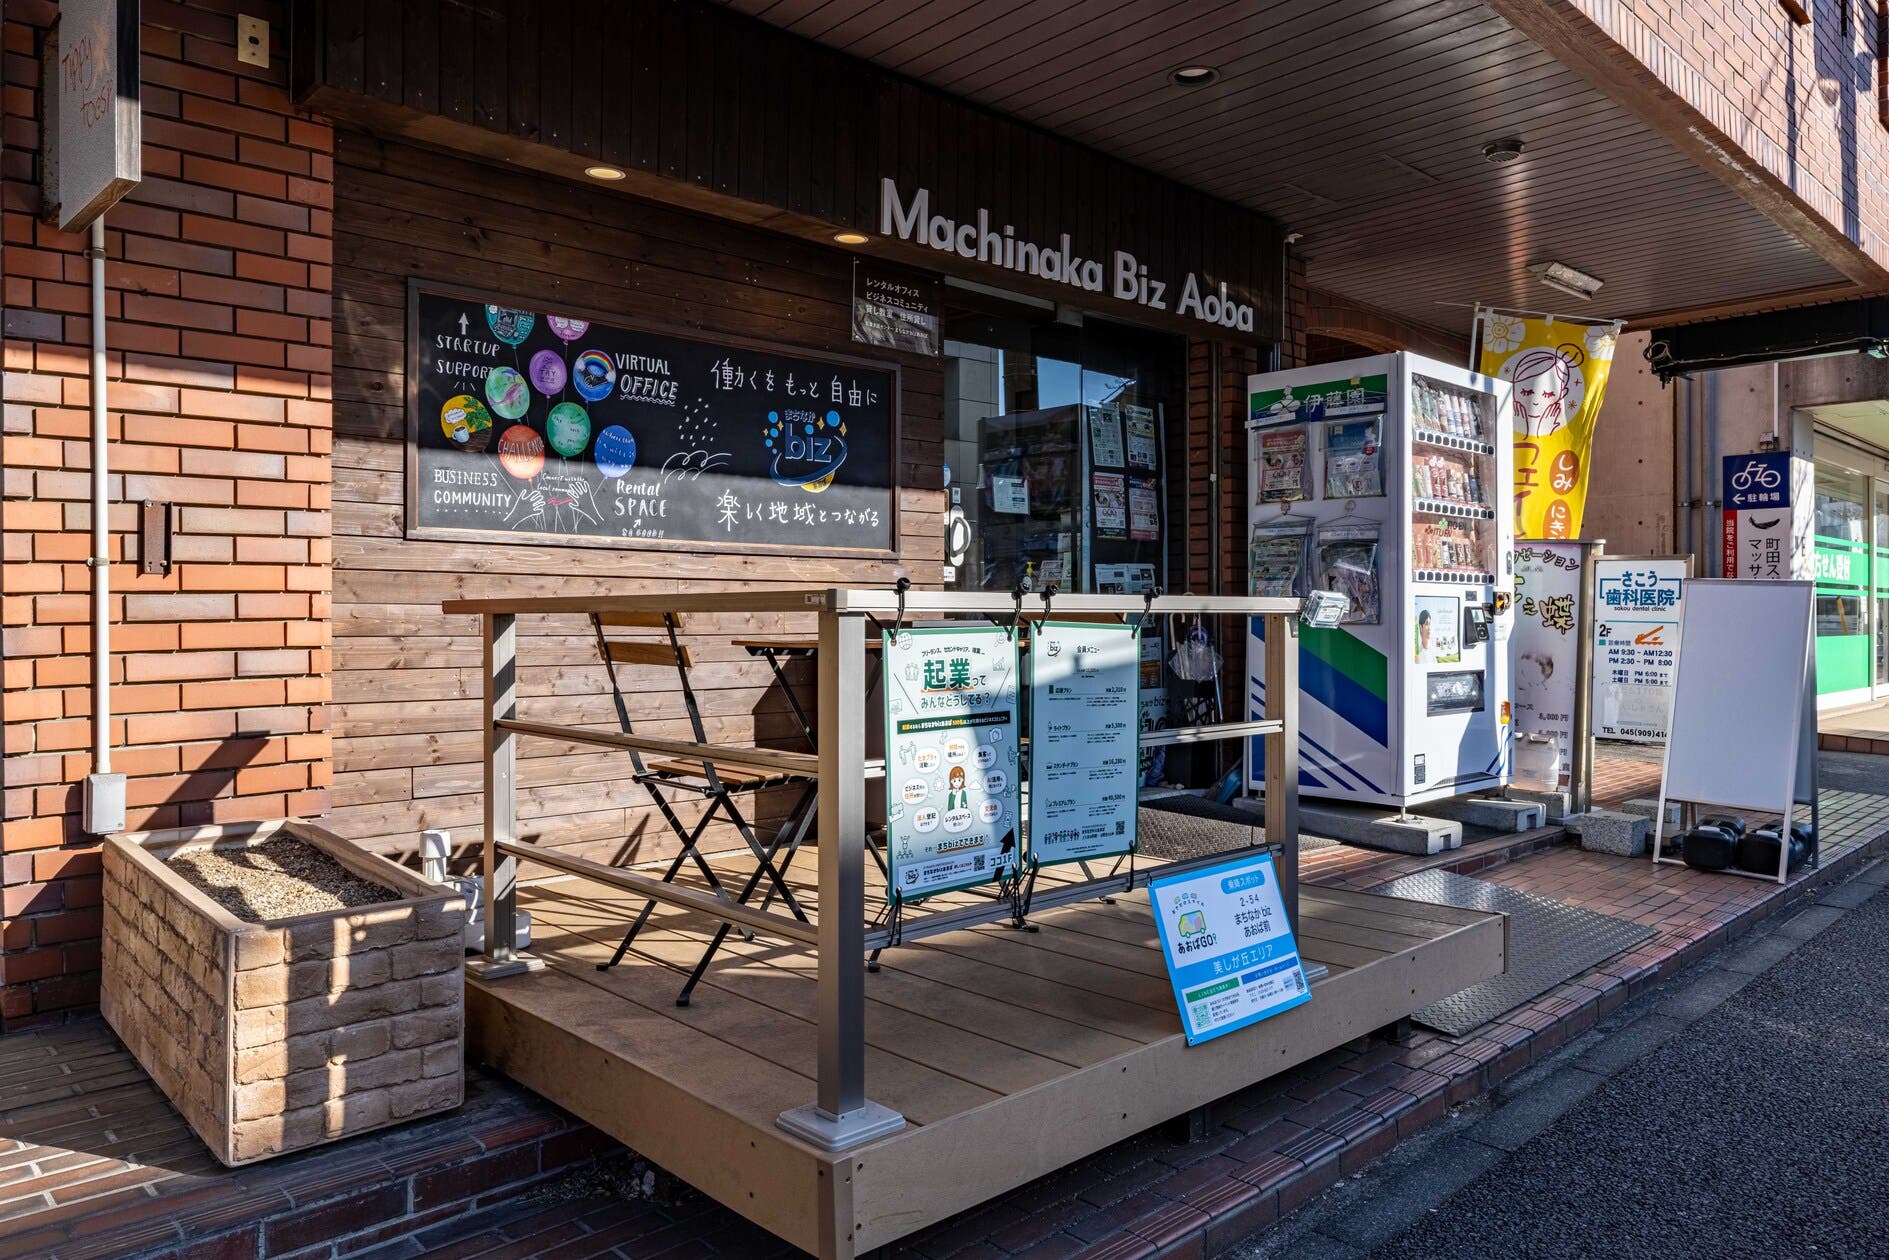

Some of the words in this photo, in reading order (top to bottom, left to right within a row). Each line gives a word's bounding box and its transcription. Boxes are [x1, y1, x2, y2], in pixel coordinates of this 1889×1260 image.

[880, 176, 1103, 292] Machinaka
[1113, 250, 1167, 310] Biz
[1176, 271, 1254, 333] Aoba
[866, 277, 920, 298] レンタルオフィス
[866, 291, 929, 313] ビジネスコミュニティ
[436, 334, 501, 357] STARTUP
[436, 359, 494, 379] SUPPORT
[615, 352, 671, 375] VIRTUAL
[620, 374, 679, 400] OFFICE
[1303, 387, 1365, 413] 伊藤園
[784, 408, 816, 424] まちなか
[785, 423, 832, 463] biz
[434, 469, 498, 486] BUSINESS
[1553, 454, 1574, 491] しみ
[617, 479, 661, 497] Rental
[1747, 492, 1781, 503] 駐輪場
[434, 490, 512, 508] COMMUNITY
[614, 498, 667, 518] SPACE
[1549, 505, 1567, 540] にき
[1748, 538, 1763, 580] マッサ
[1765, 537, 1781, 580] 町田ス
[1621, 570, 1658, 588] さこう
[1605, 588, 1675, 607] 歯科医院
[1599, 624, 1612, 637] 2F
[1077, 645, 1100, 653] 会員メニュー
[1608, 657, 1619, 665] PM
[1643, 658, 1655, 666] PM
[923, 657, 987, 690] 起業って
[1602, 726, 1616, 734] TEL
[1239, 894, 1260, 907] 2-54
[1243, 920, 1272, 938] あおば前
[1212, 944, 1273, 975] 美しが丘エリア
